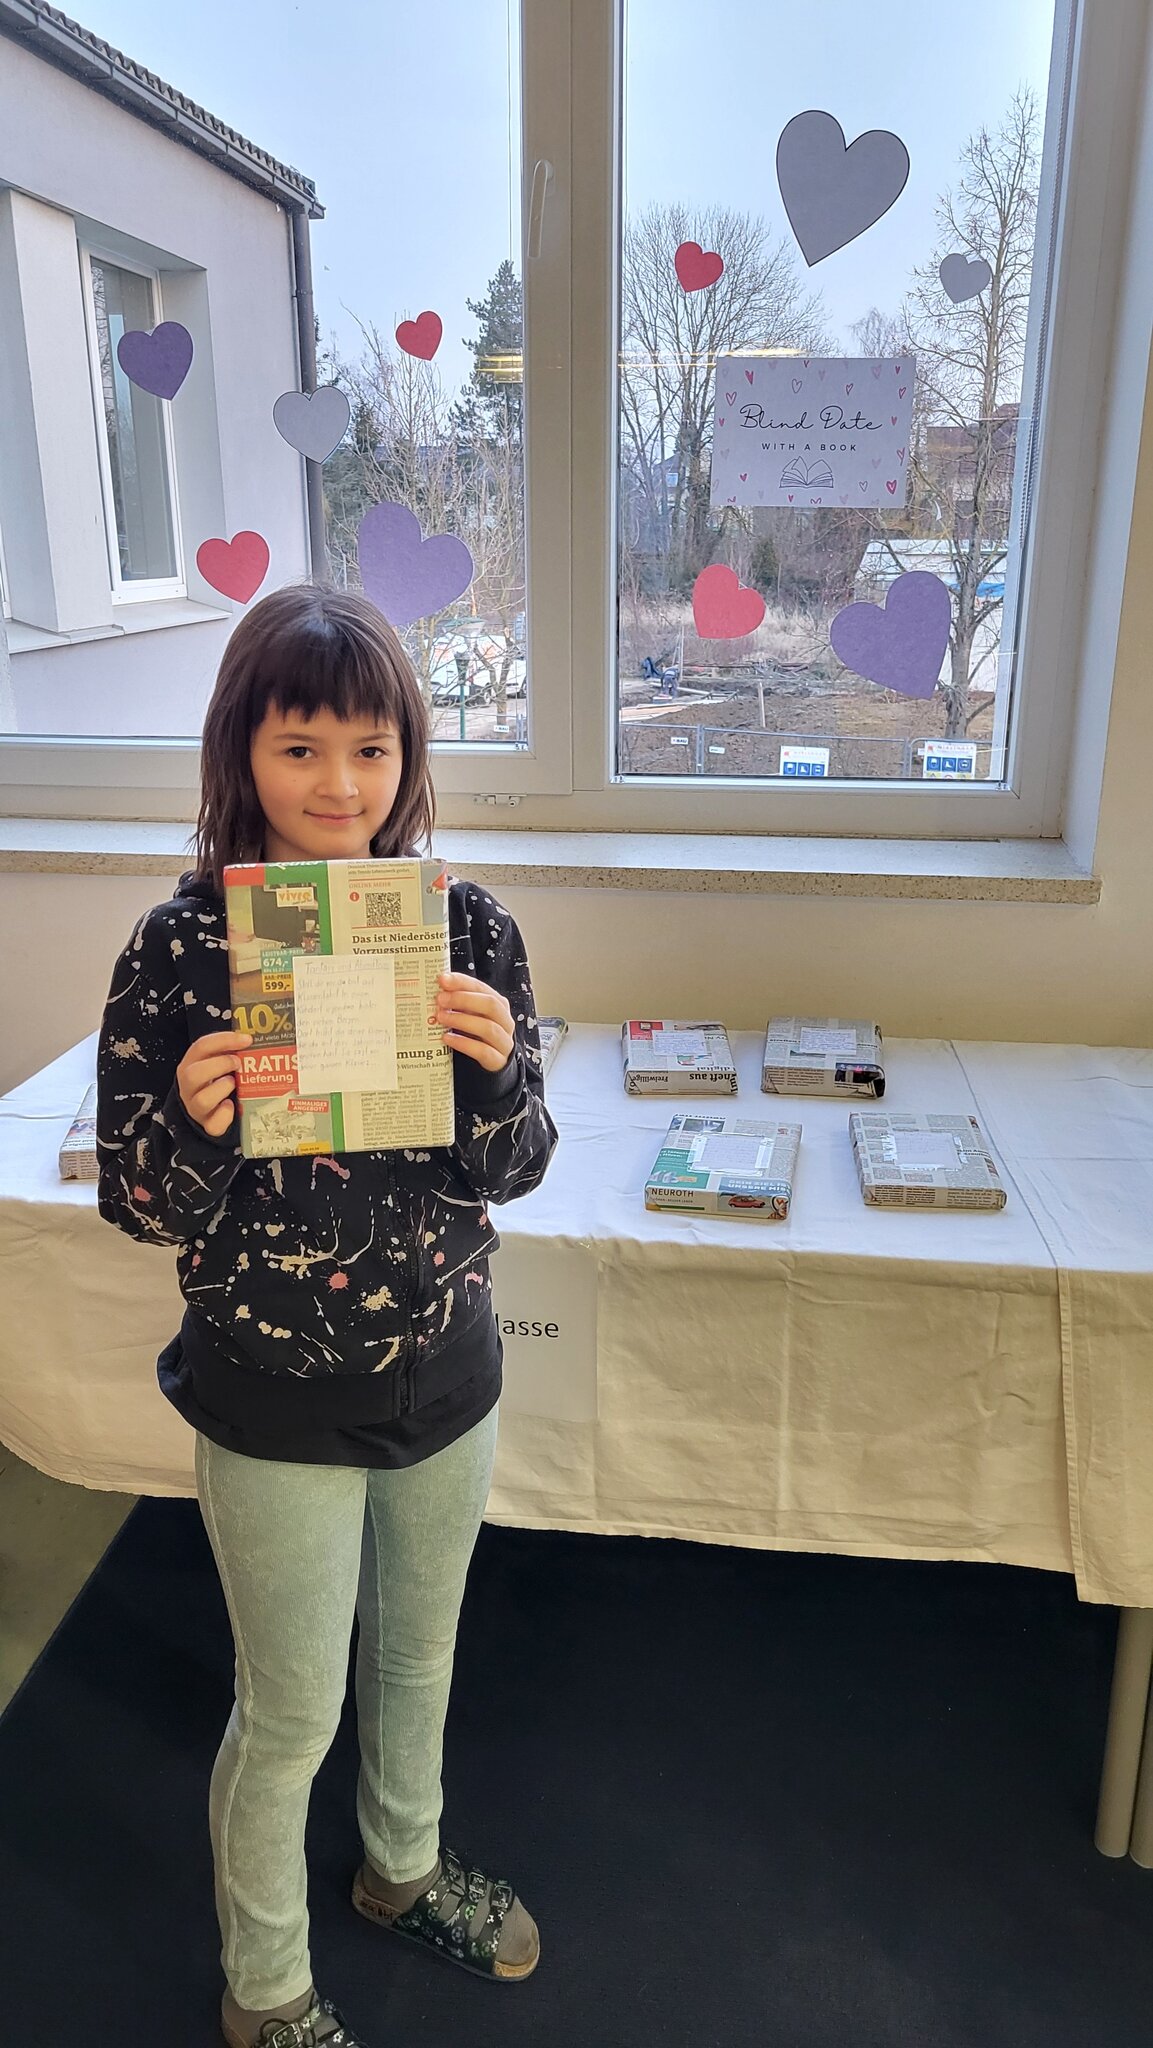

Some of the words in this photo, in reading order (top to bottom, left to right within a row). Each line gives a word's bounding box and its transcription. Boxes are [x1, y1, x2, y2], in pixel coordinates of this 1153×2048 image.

[740, 404, 814, 429] Blind
[820, 405, 882, 430] Date
[762, 443, 796, 451] WITH
[804, 443, 811, 451] A
[820, 444, 856, 452] BOOK
[352, 935, 371, 944] Das
[374, 934, 387, 943] ist
[263, 958, 288, 968] 674,-
[265, 982, 290, 990] 599,-
[233, 1004, 292, 1034] 10%
[396, 1049, 434, 1060] mung
[401, 1062, 431, 1070] Wirtschaft
[240, 1074, 294, 1084] Lieferung
[632, 1074, 668, 1083] Freiwillige
[652, 1188, 694, 1198] NEUROTH
